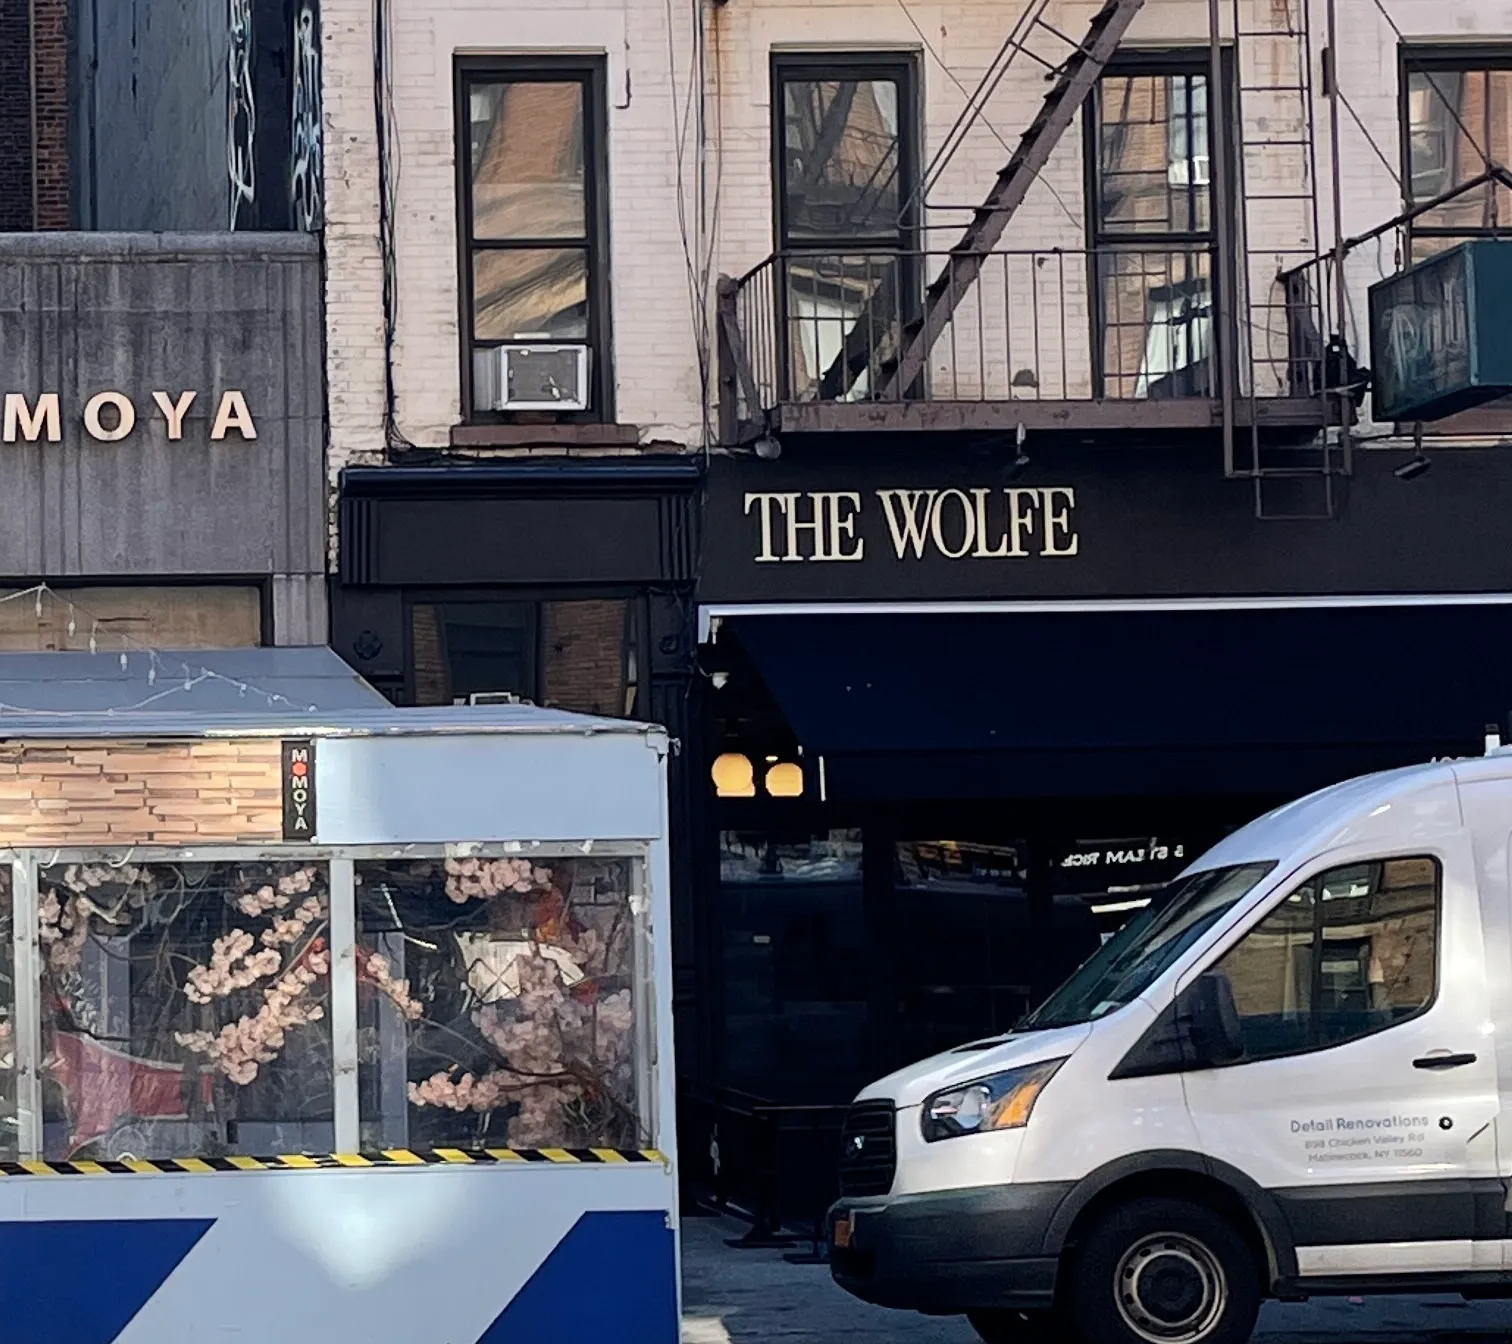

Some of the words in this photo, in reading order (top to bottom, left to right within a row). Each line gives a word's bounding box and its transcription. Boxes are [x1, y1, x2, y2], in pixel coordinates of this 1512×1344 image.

[744, 491, 864, 562] THE
[875, 487, 1078, 559] WOLFE
[1290, 1117, 1333, 1133] Detail
[1337, 1114, 1429, 1130] Renovations
[1373, 1133, 1404, 1145] Valley
[1408, 1131, 1425, 1142] Rd
[1374, 1149, 1390, 1159] NY
